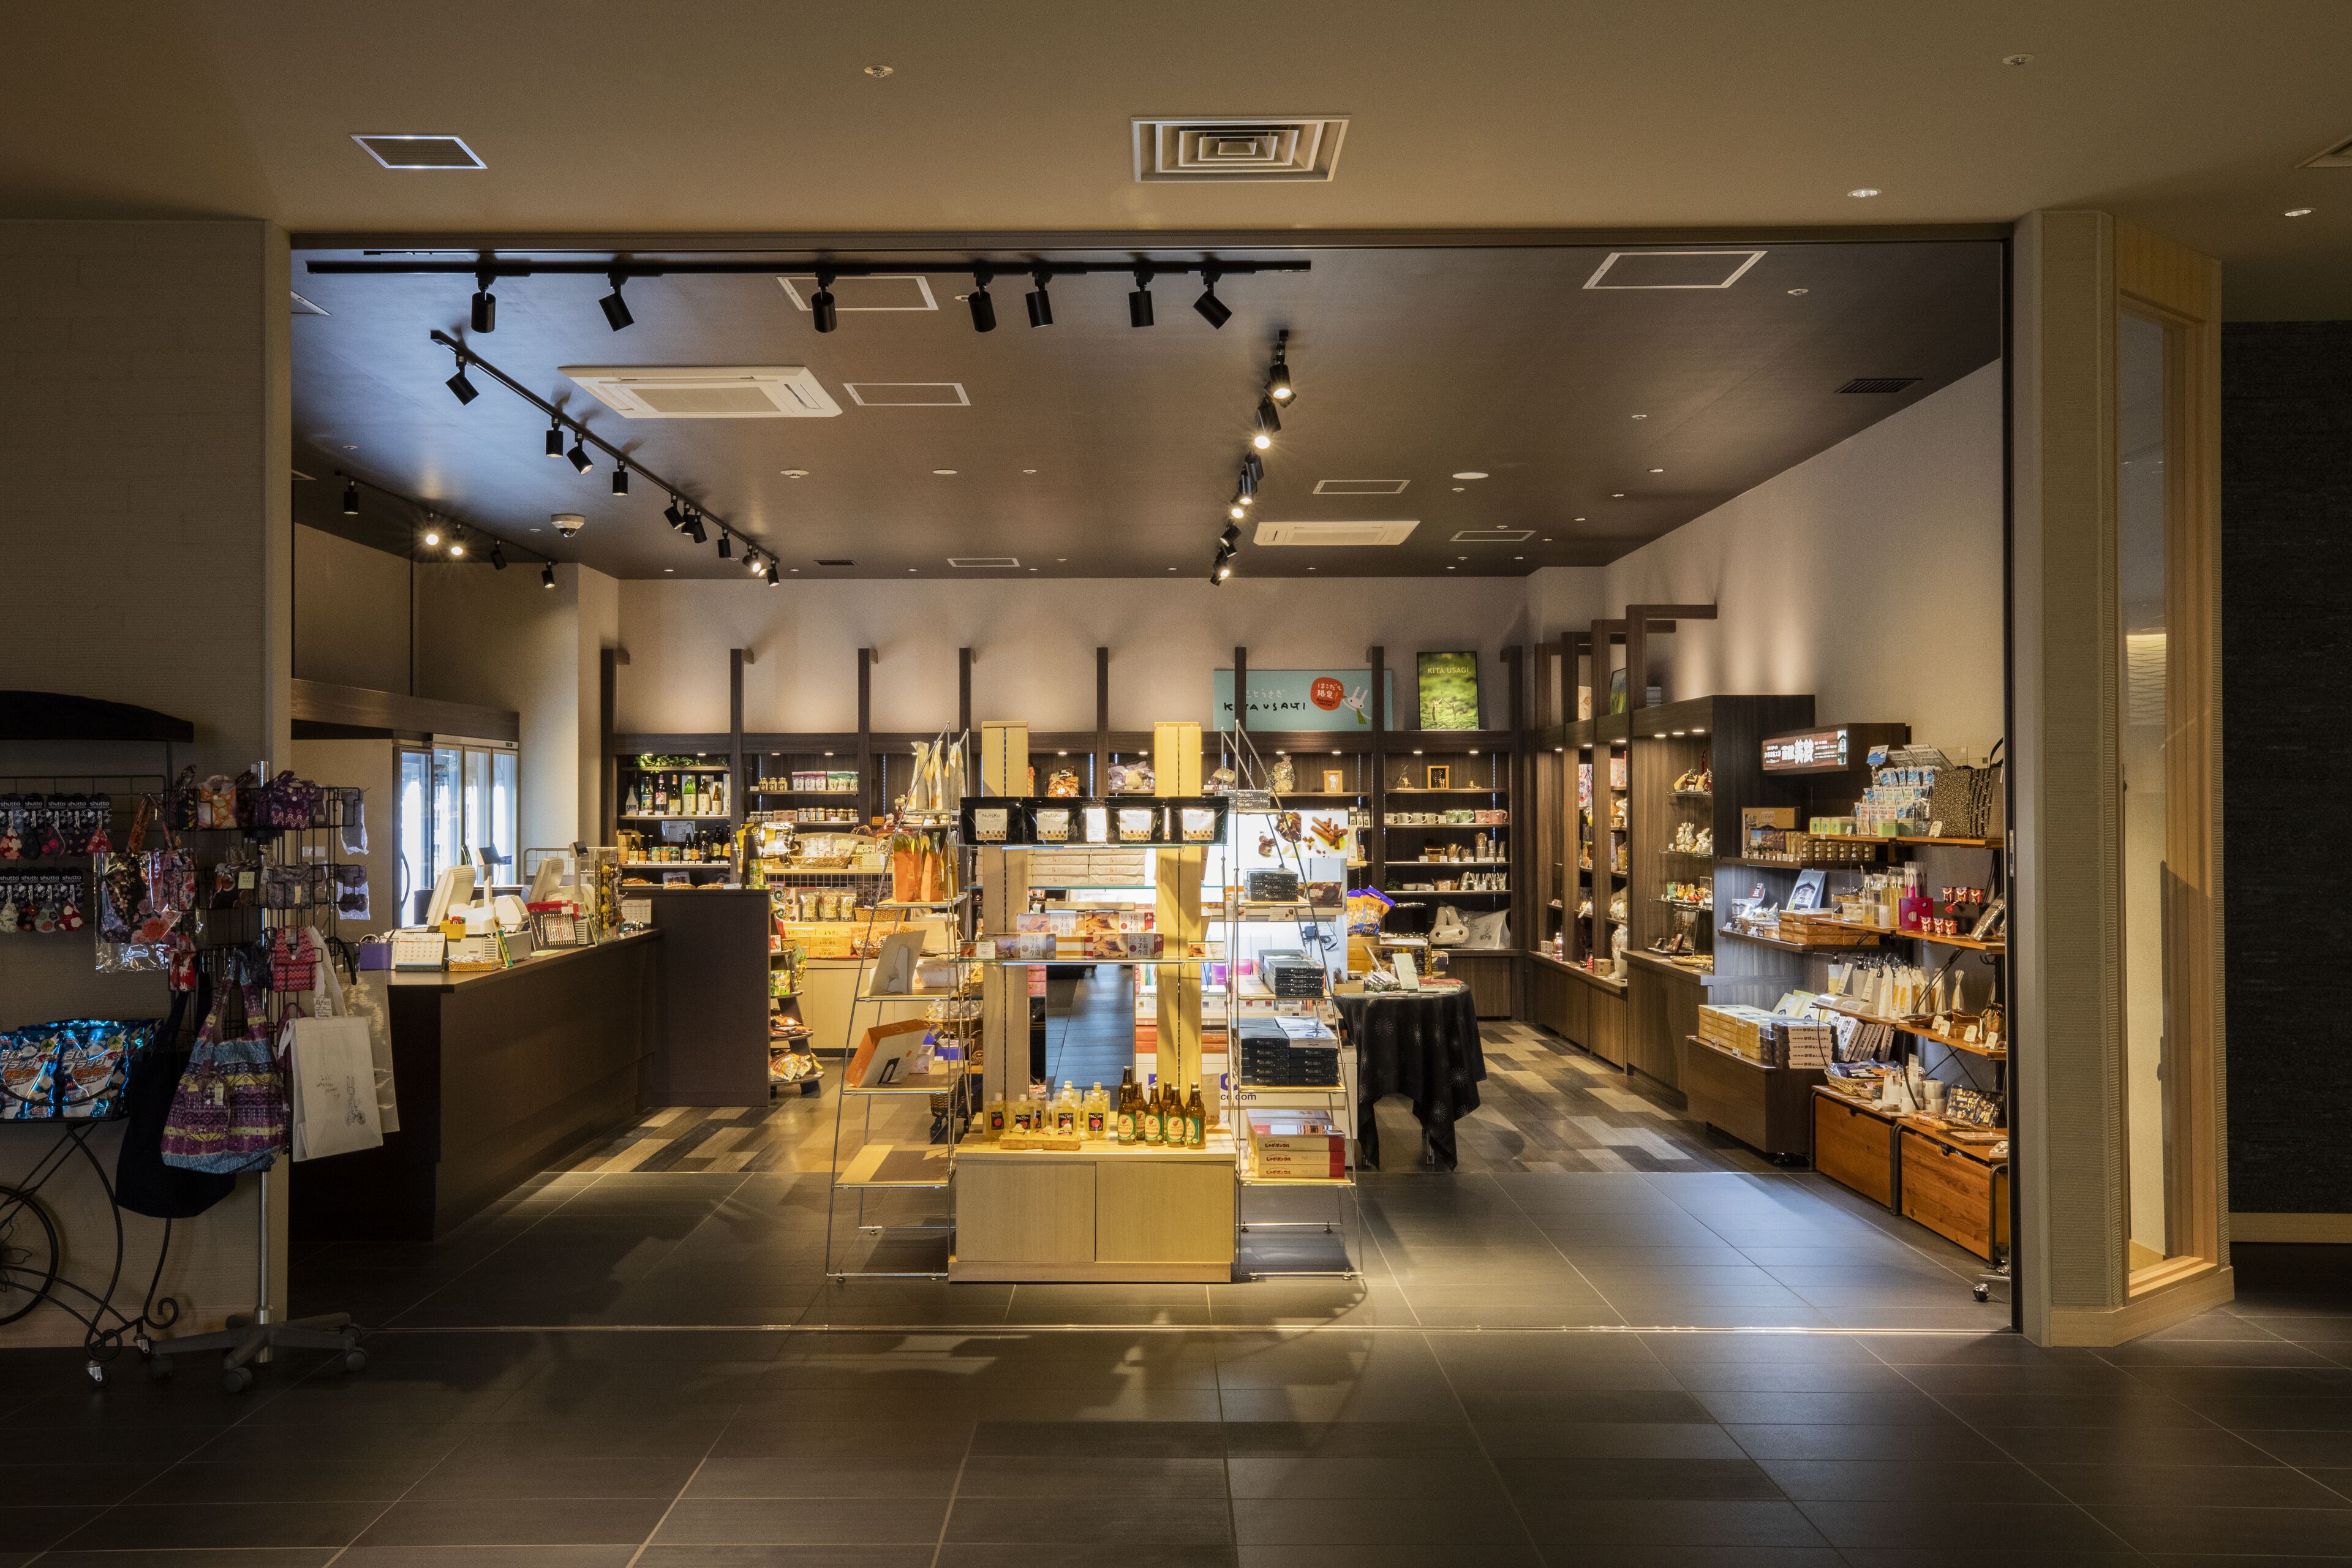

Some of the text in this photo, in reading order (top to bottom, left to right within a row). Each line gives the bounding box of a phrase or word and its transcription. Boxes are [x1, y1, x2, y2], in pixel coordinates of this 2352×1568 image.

[1317, 682, 1341, 691] はこだて
[1224, 702, 1259, 711] KTA
[64, 1050, 88, 1060] 白い
[62, 1058, 106, 1075] ブラック
